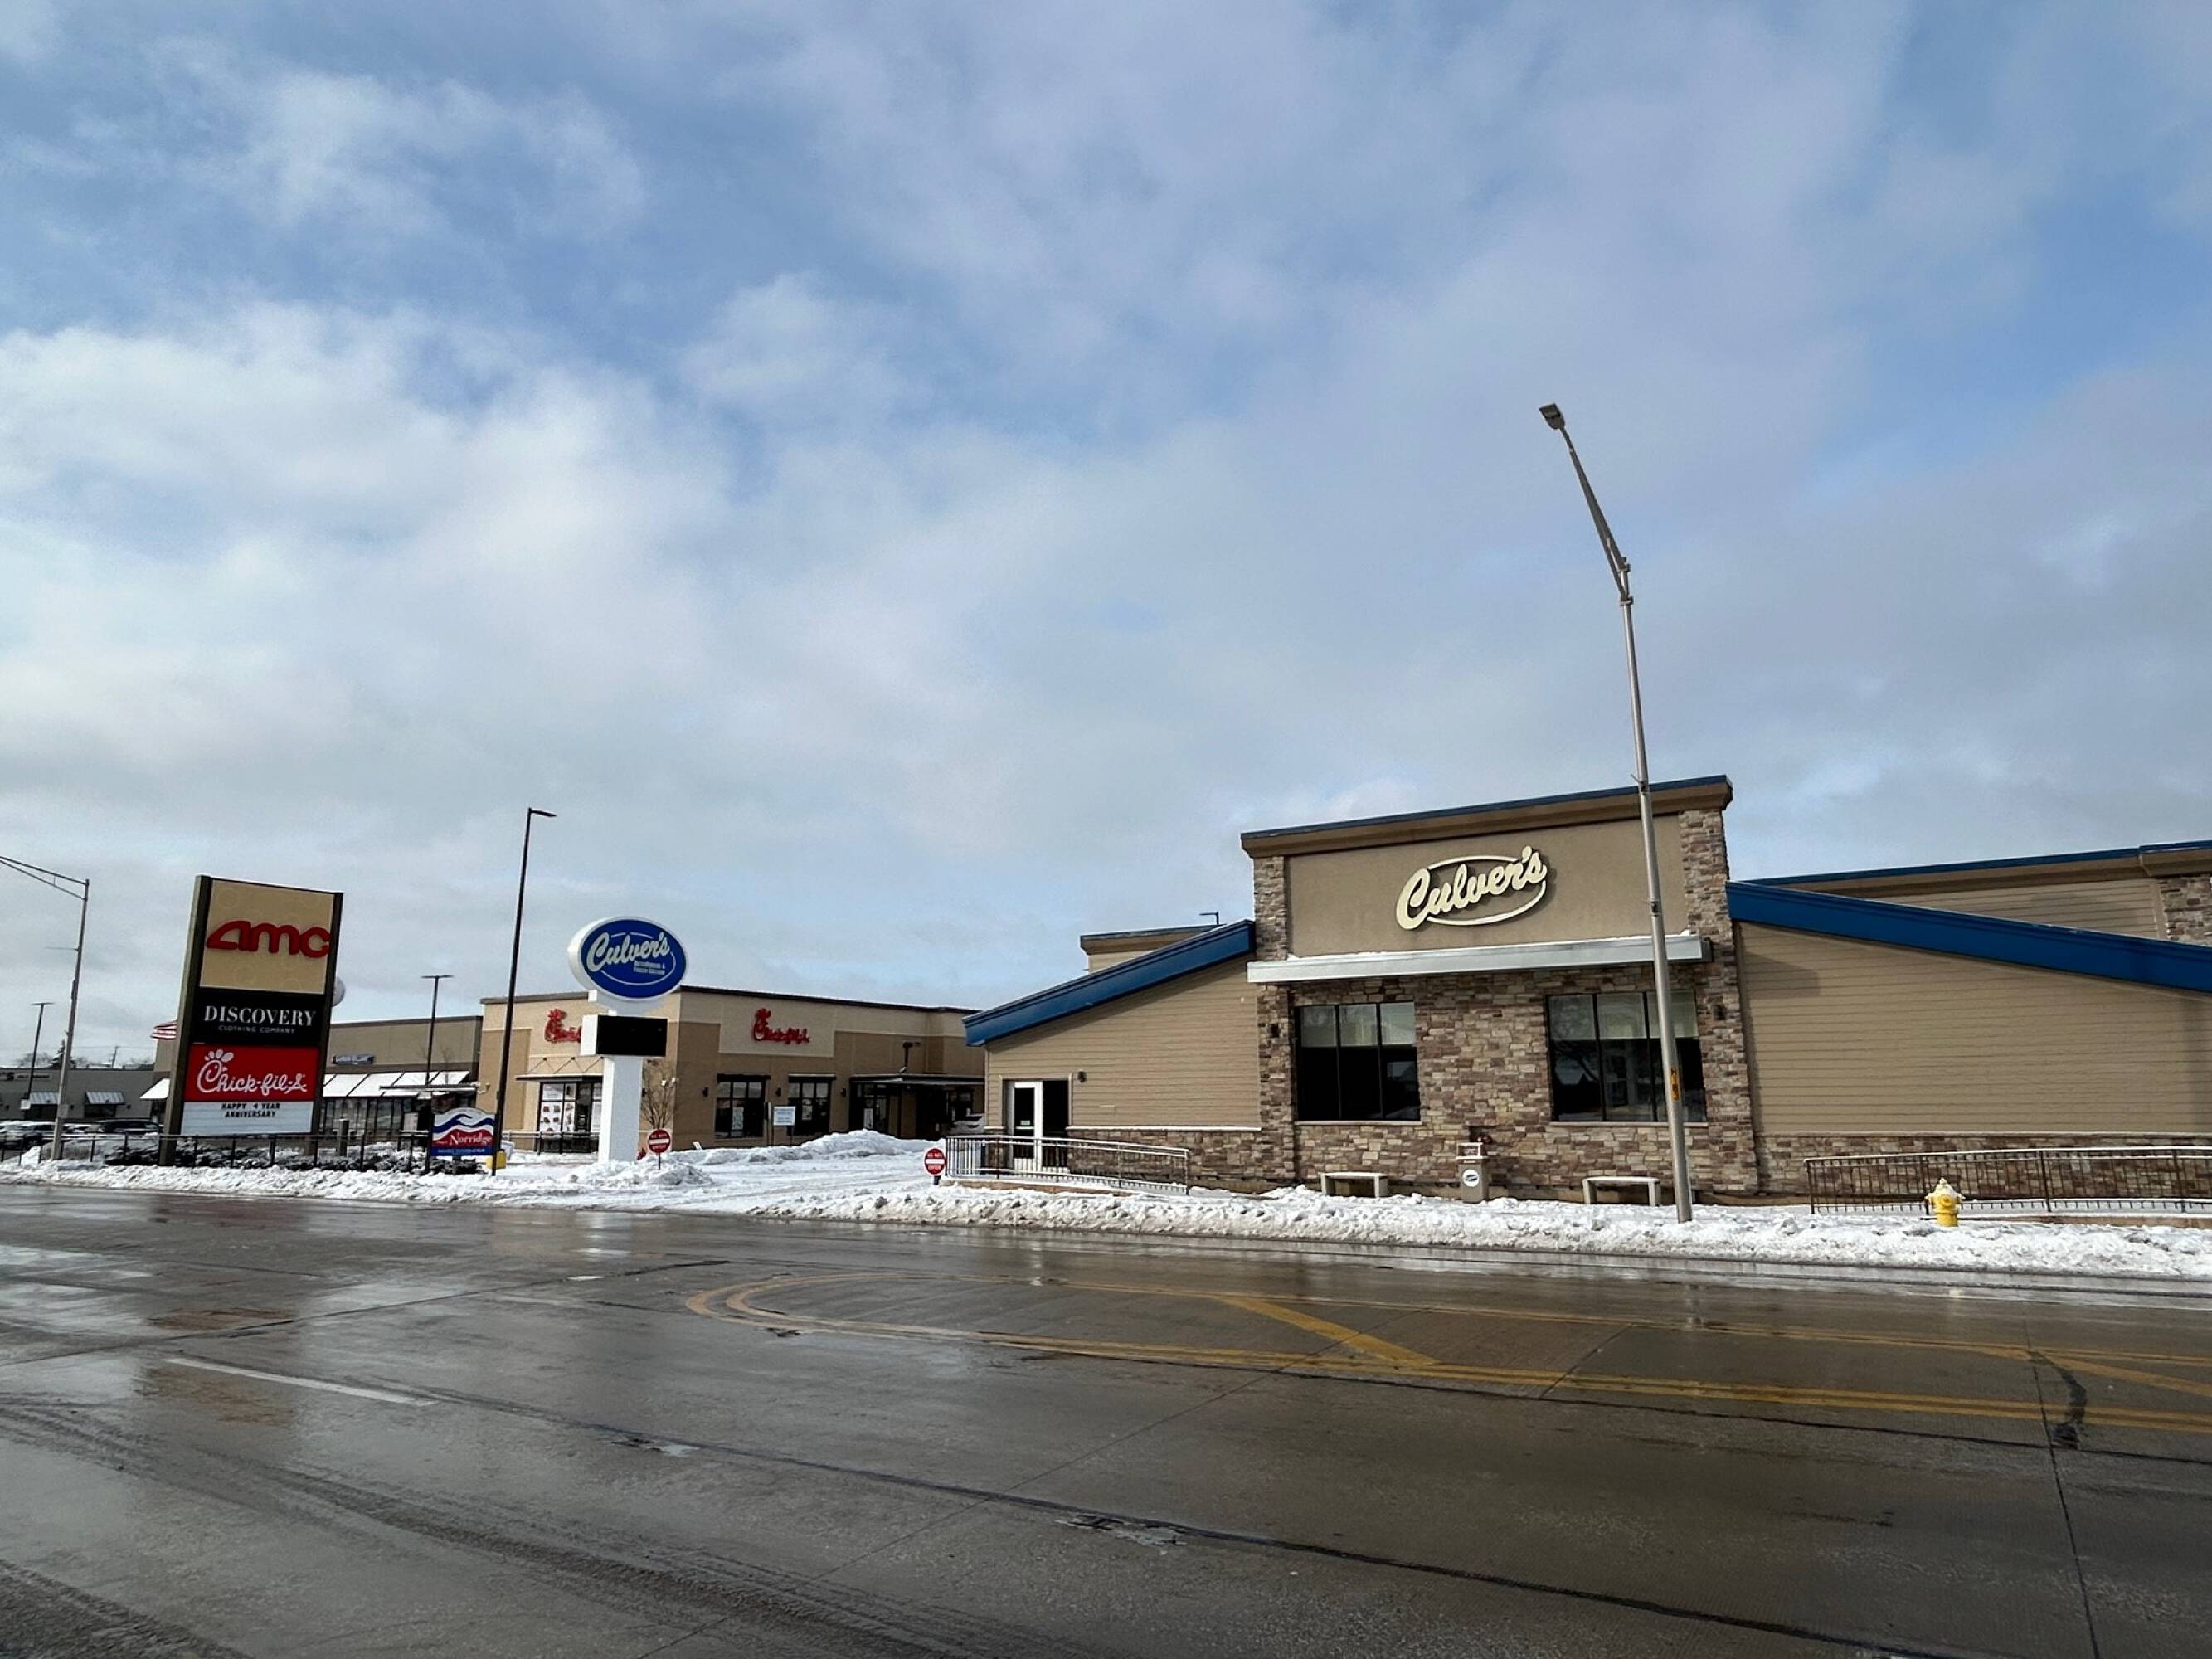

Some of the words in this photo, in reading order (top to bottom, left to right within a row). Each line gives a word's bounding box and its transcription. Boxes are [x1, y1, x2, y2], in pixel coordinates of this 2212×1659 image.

[1396, 845, 1548, 930] Culver's
[586, 932, 670, 972] Culver's
[204, 1005, 317, 1026] DISCOVERY
[218, 1024, 256, 1033] CLOTHING
[259, 1026, 295, 1034] COMPANY
[197, 1058, 308, 1096] Chick-fil-A
[221, 1102, 246, 1110] HAPPY
[450, 1131, 492, 1146] Norridge
